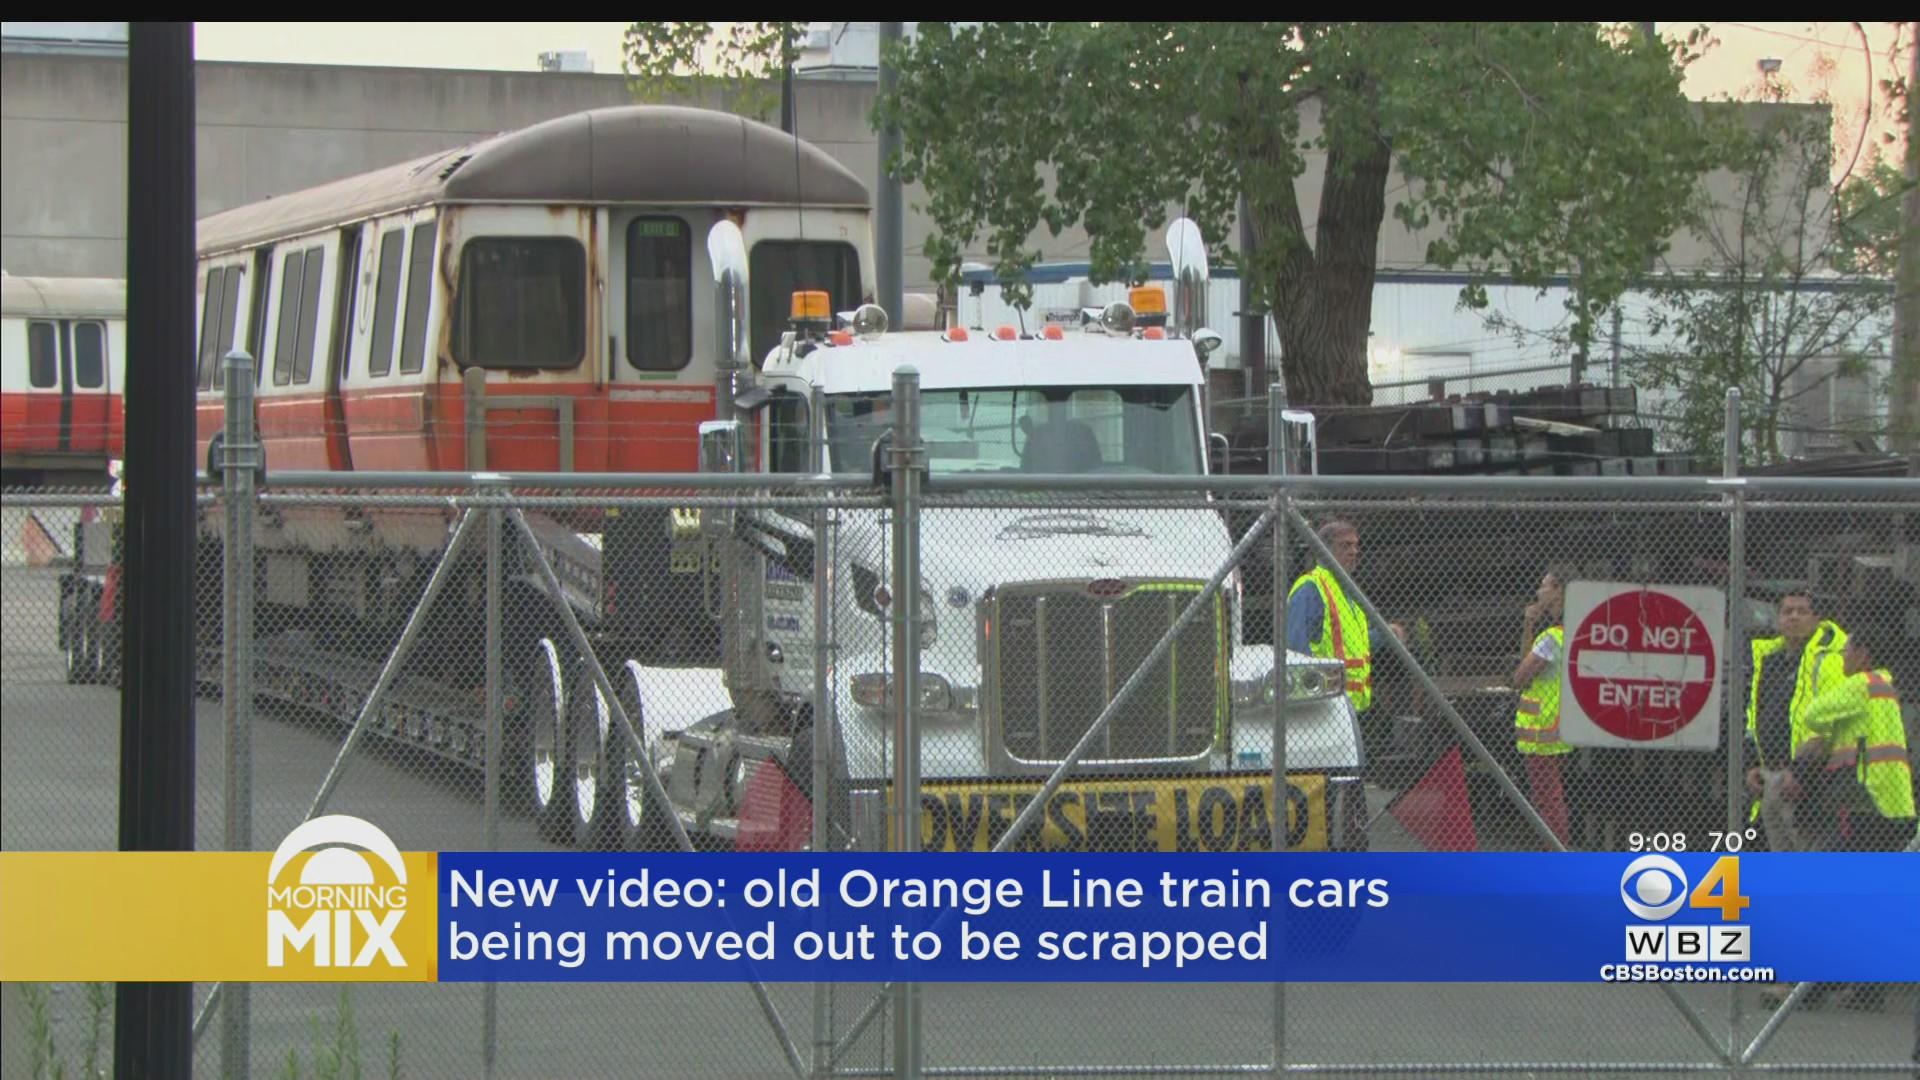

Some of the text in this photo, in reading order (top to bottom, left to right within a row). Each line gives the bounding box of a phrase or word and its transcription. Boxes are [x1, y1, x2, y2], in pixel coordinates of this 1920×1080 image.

[1590, 624, 1697, 649] DO NOT
[1598, 683, 1682, 709] ENTER
[1174, 784, 1309, 852] LOAD
